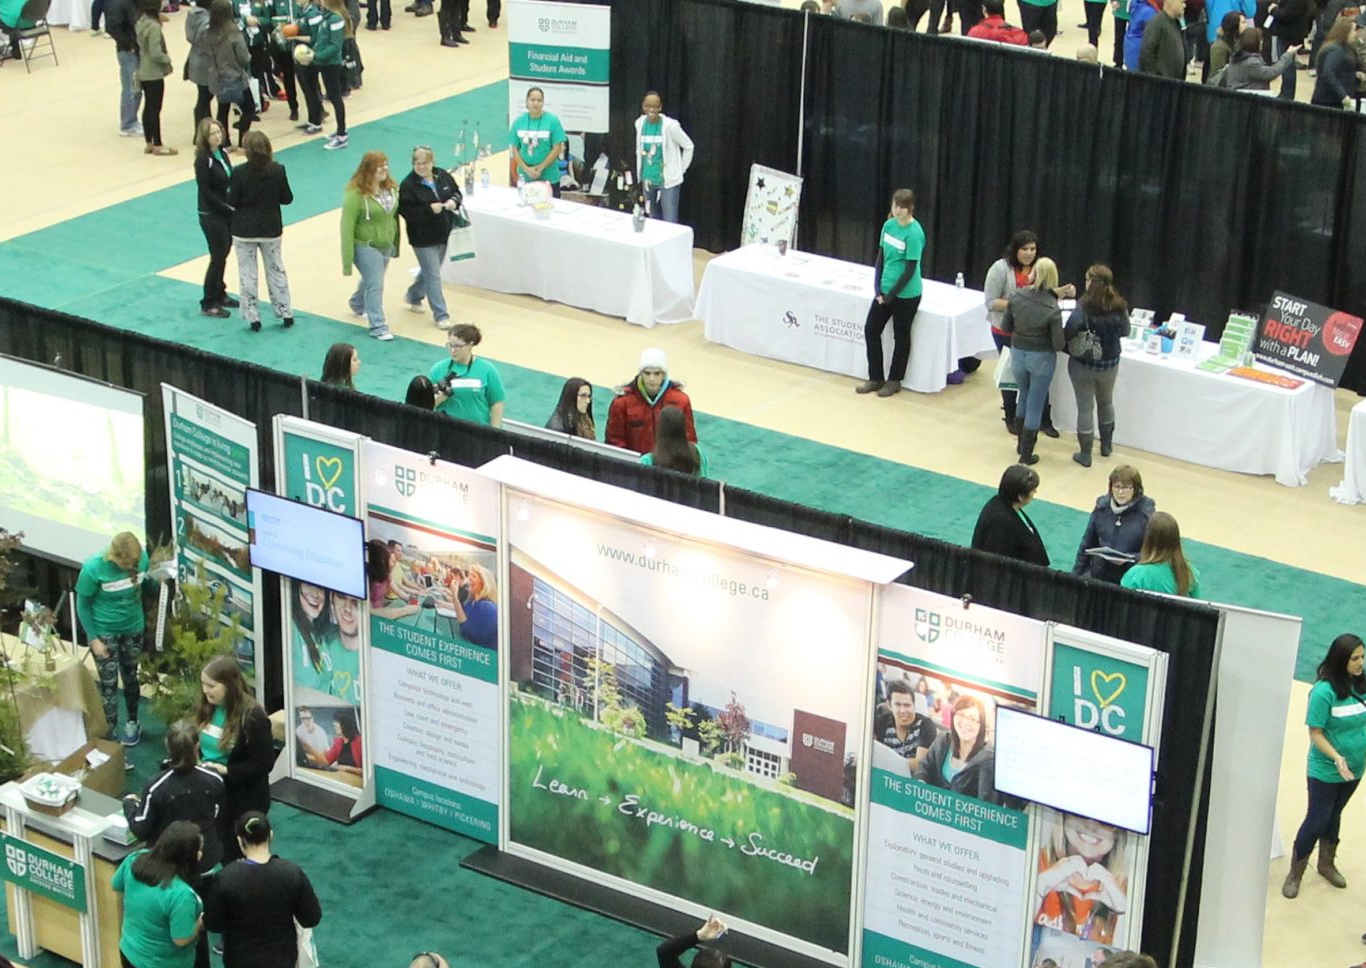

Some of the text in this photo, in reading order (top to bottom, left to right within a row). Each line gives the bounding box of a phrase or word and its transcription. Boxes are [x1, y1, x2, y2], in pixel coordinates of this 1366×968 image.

[528, 50, 588, 64] Financial Aid and
[530, 62, 586, 76] Student Awards
[815, 314, 830, 326] THE
[1273, 296, 1308, 317] START
[1263, 320, 1314, 347] RIGHT
[1280, 310, 1303, 327] Your
[1301, 317, 1321, 337] Day
[1259, 338, 1321, 368] with a PLAN!
[1333, 337, 1351, 349] EASY
[176, 470, 181, 488] 1
[302, 453, 311, 480] I
[306, 482, 346, 514] DC
[178, 516, 185, 536] 2
[179, 564, 187, 583] 3
[945, 616, 1005, 642] DURHAM
[379, 621, 491, 666] THE STUDENT EXPERIENCE
[406, 643, 463, 669] COMES FIRST
[1073, 665, 1082, 696] I
[1074, 698, 1126, 736] DC
[411, 786, 435, 800] Campus
[883, 776, 1018, 829] THE STUDENT EXPERIENCE
[385, 788, 491, 832] OSHAWA WHITBY PICKERING
[533, 765, 819, 875] Learn Experience Succeed
[915, 802, 983, 832] COMES FIRST
[27, 852, 74, 881] DURHAM
[29, 864, 74, 891] COLLEGE
